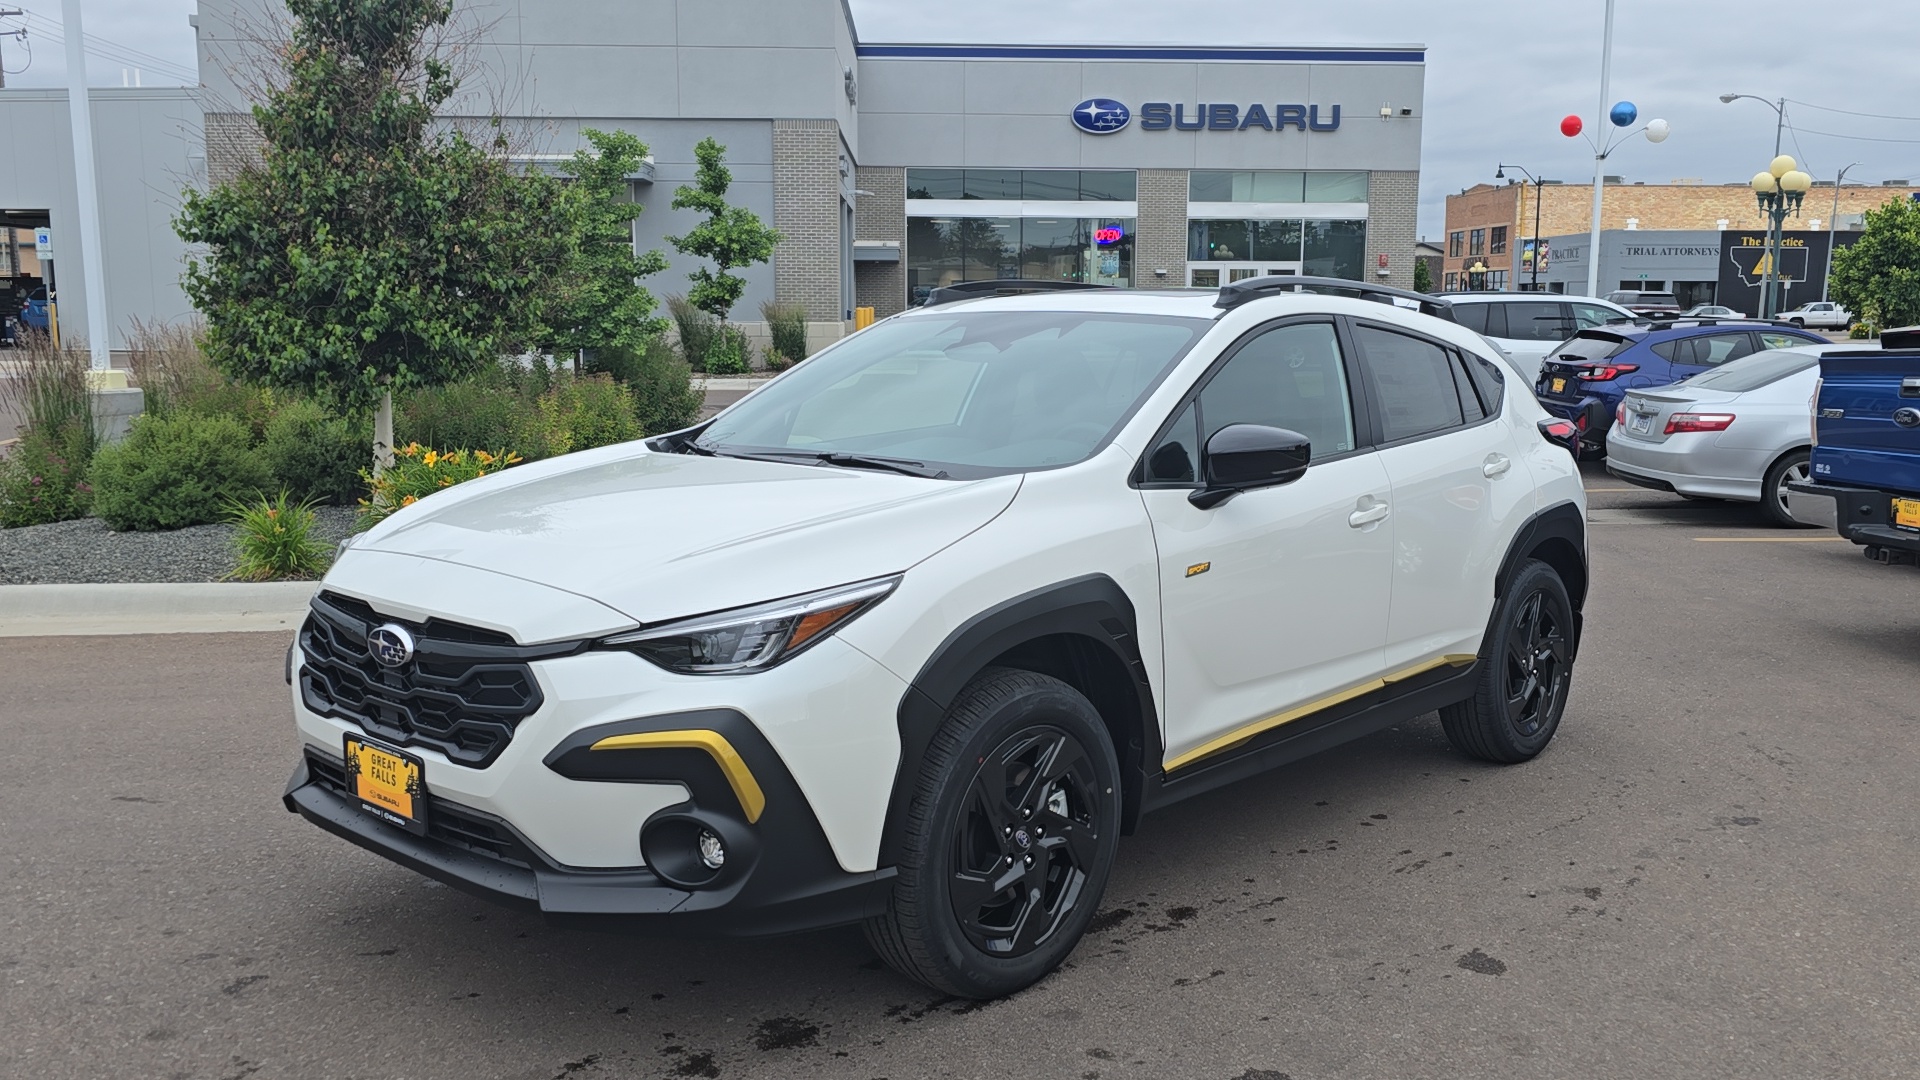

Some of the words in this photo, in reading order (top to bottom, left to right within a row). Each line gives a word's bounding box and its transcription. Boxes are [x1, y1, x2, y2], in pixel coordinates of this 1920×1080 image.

[1141, 103, 1341, 131] SUBARU
[1095, 229, 1120, 241] OPEN
[1741, 236, 1761, 247] The
[1764, 236, 1804, 247] rctice
[1551, 248, 1580, 260] PRACTICE
[1626, 247, 1658, 256] TRIAL
[1660, 247, 1720, 256] ATTORNEYS
[1188, 562, 1209, 575] SPORT
[371, 753, 397, 772] GREAT
[371, 767, 397, 786] FALLS
[376, 793, 400, 807] SUBARU
